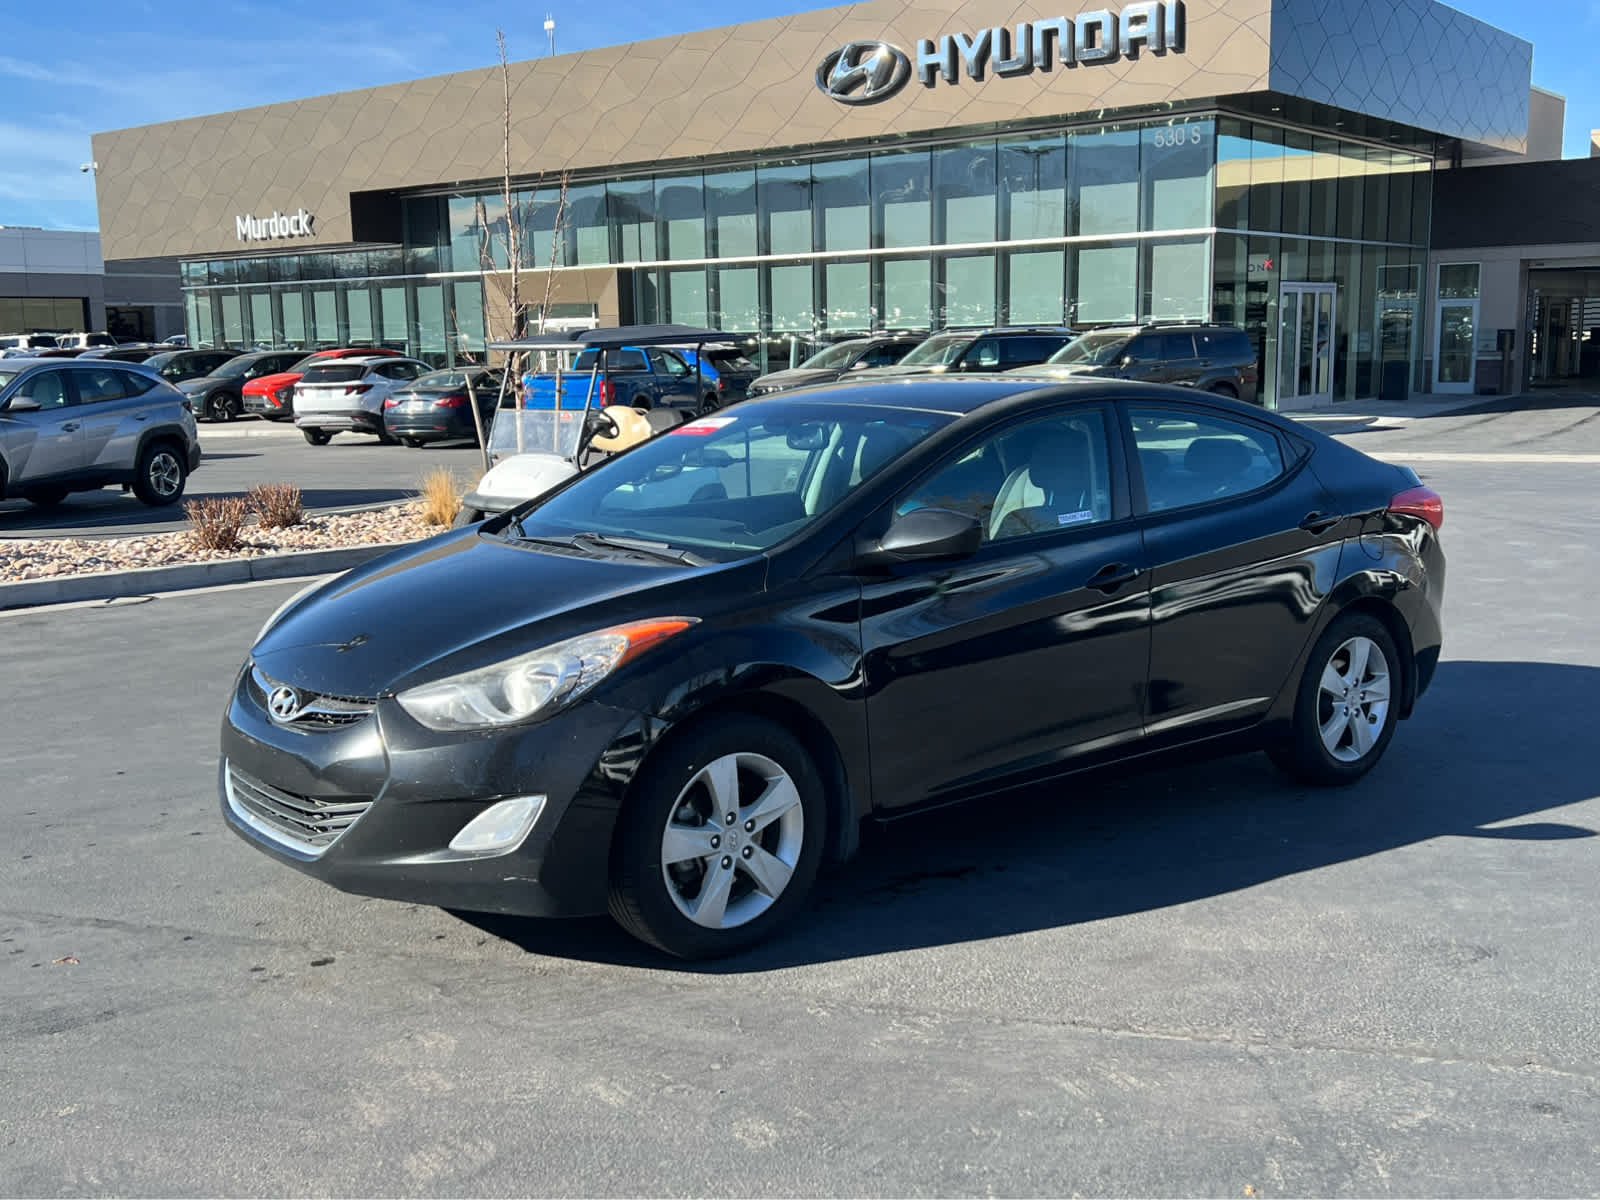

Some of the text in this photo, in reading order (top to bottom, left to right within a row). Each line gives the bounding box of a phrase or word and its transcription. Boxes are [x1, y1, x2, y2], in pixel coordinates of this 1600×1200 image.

[916, 0, 1185, 87] HYUNDAI
[1191, 126, 1201, 144] S
[236, 208, 313, 241] Murdock
